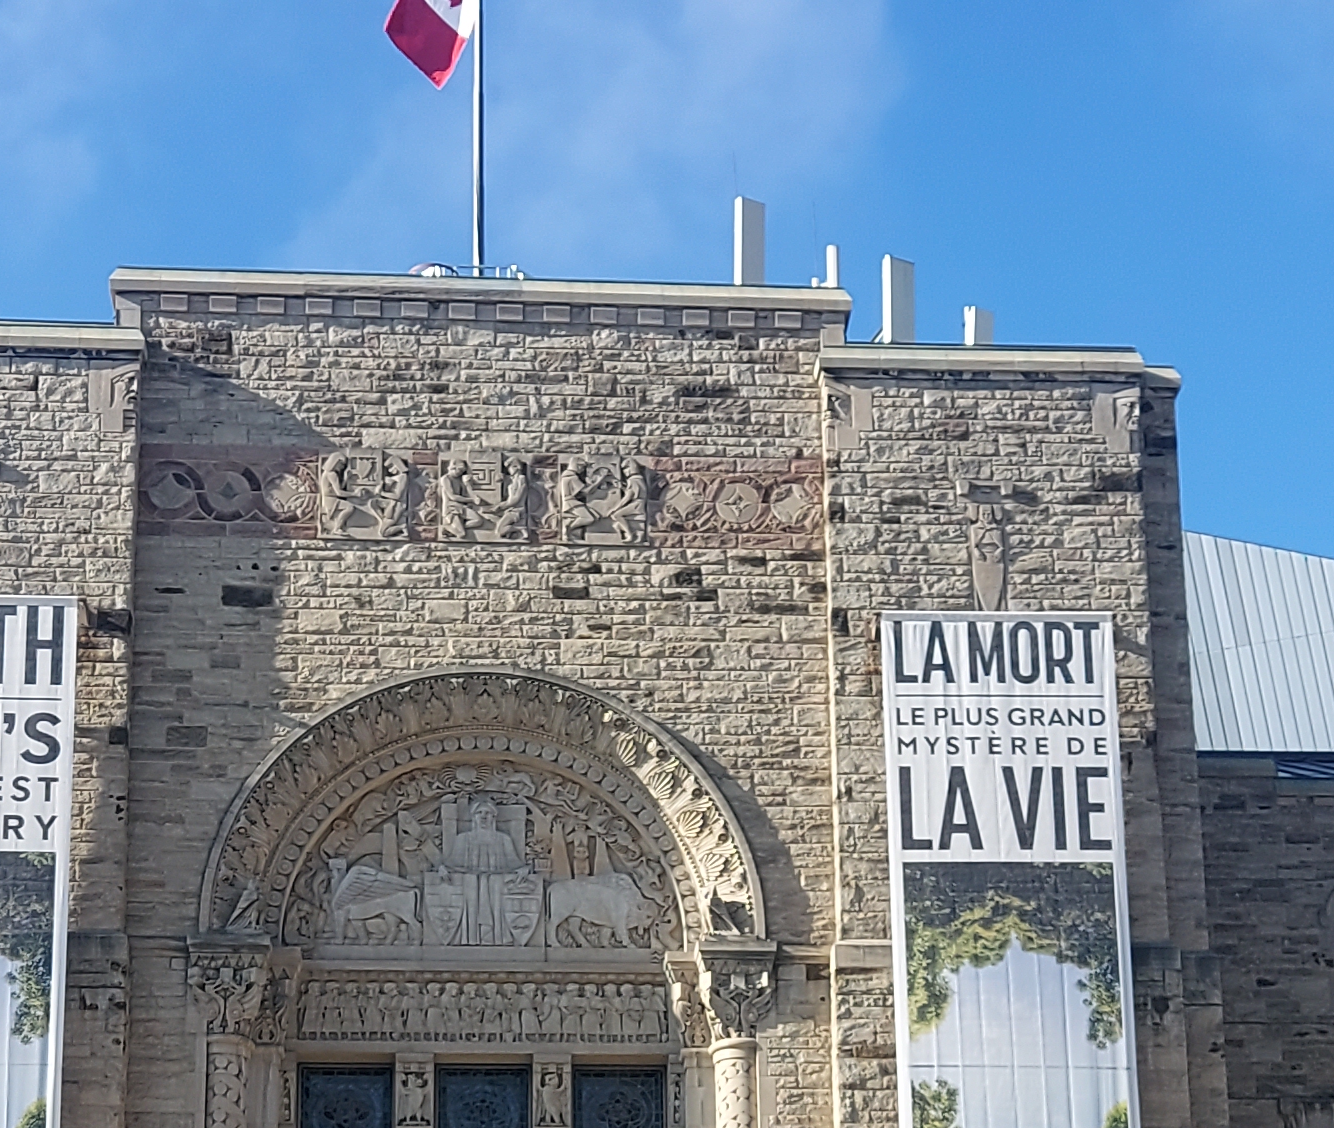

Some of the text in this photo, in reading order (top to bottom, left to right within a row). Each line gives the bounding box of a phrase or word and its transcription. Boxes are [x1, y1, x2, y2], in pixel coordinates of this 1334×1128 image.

[893, 621, 1100, 684] LA MORT
[896, 707, 1106, 726] LE PLUS GRAND
[897, 731, 1108, 755] MYSTÈRE DE
[898, 766, 1113, 850] LA VIE
